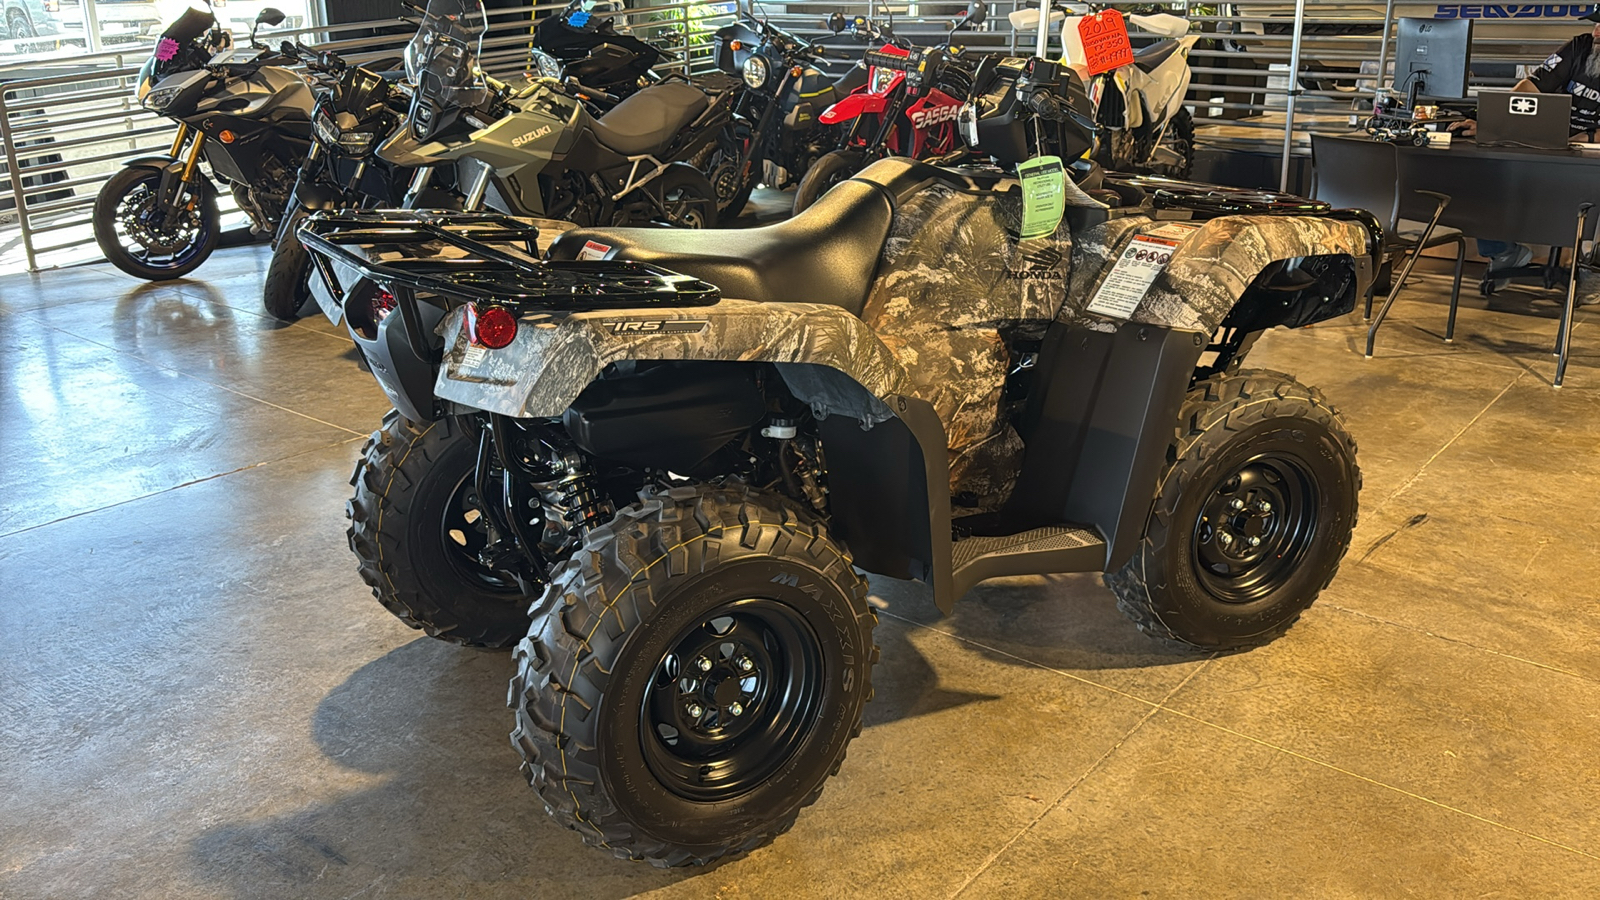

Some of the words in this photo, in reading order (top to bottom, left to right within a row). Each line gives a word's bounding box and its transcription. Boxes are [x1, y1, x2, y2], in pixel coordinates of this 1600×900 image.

[1083, 16, 1117, 37] 2019
[911, 104, 958, 129] GASGA
[511, 124, 552, 147] SUZUKI
[1006, 270, 1063, 280] HONDA
[613, 321, 662, 331] IRS
[769, 572, 855, 693] MAXXIS
